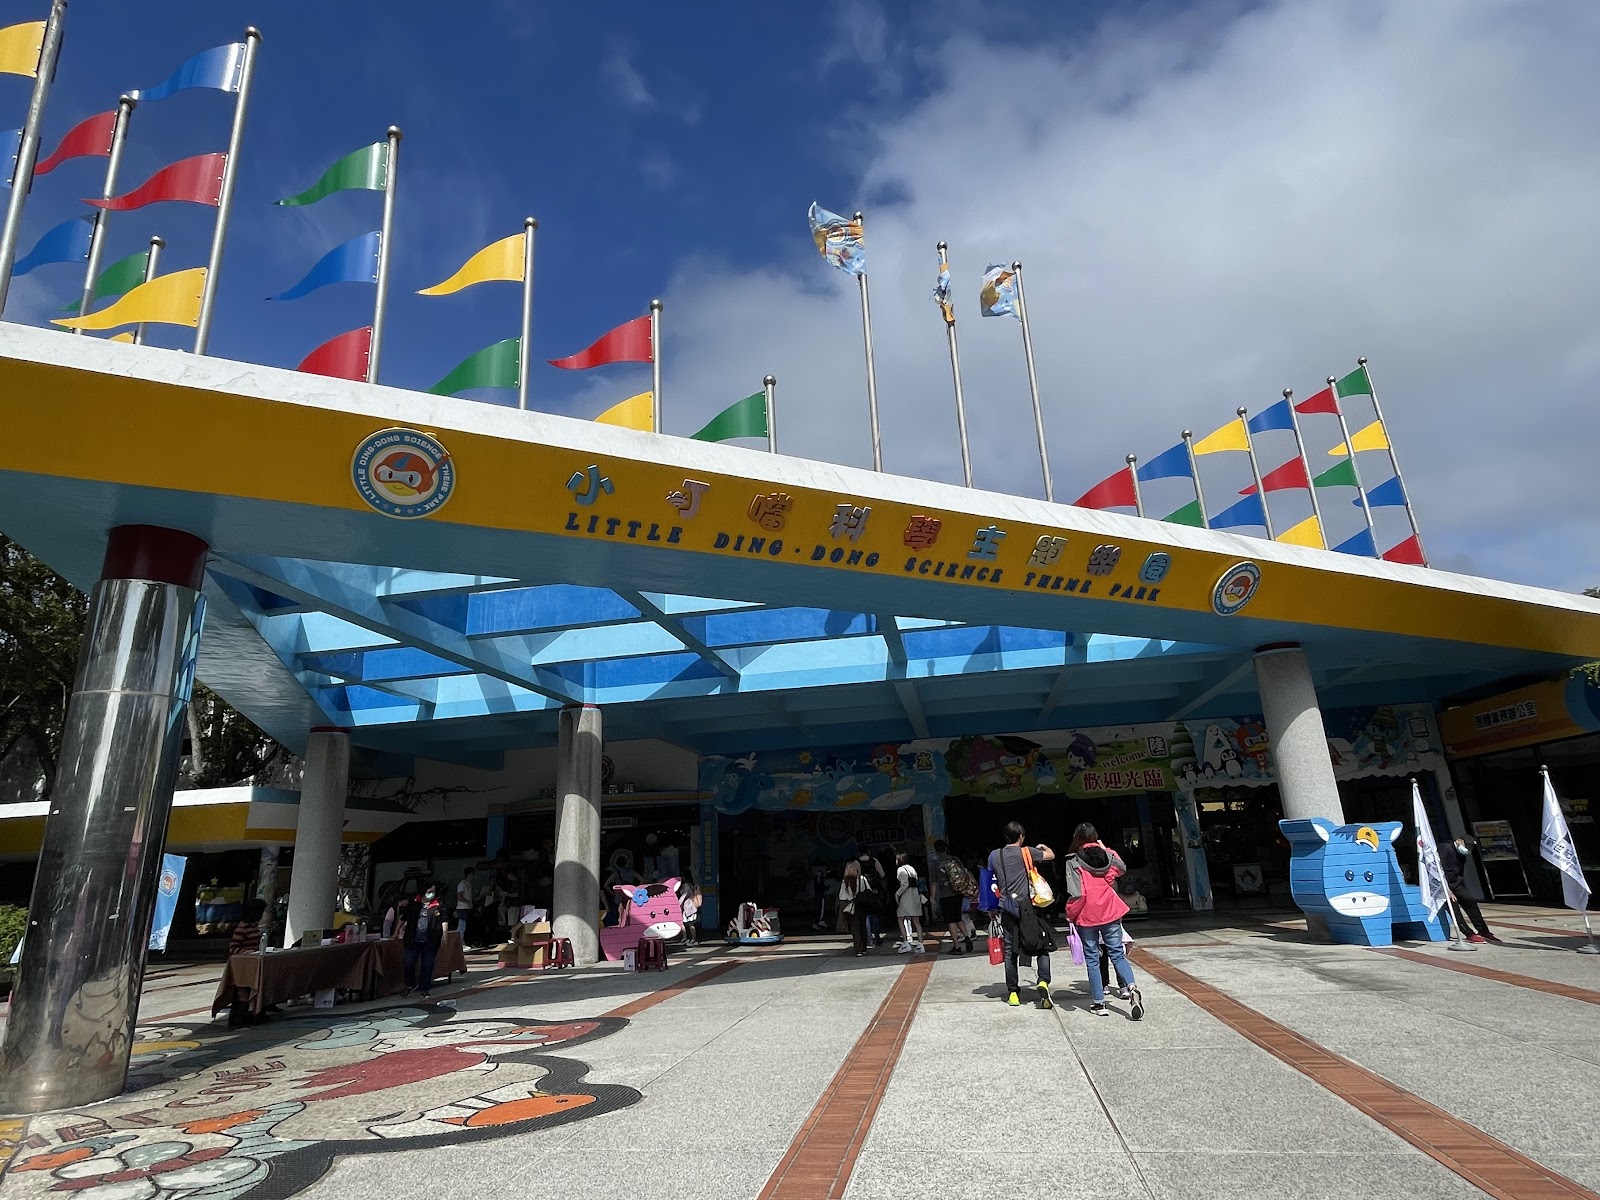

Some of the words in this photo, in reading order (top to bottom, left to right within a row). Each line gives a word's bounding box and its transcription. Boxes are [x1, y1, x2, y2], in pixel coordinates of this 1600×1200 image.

[404, 435, 442, 460] SCIENCE
[358, 468, 377, 500] LITTLE
[441, 464, 451, 492] THEME
[423, 494, 444, 511] PARK
[564, 512, 683, 544] LITTLE
[904, 557, 1004, 584] SCIENCE
[1024, 572, 1093, 594] THEME
[1108, 583, 1161, 602] PARK
[1101, 749, 1147, 770] welcome
[1082, 768, 1164, 792] 歡迎光臨
